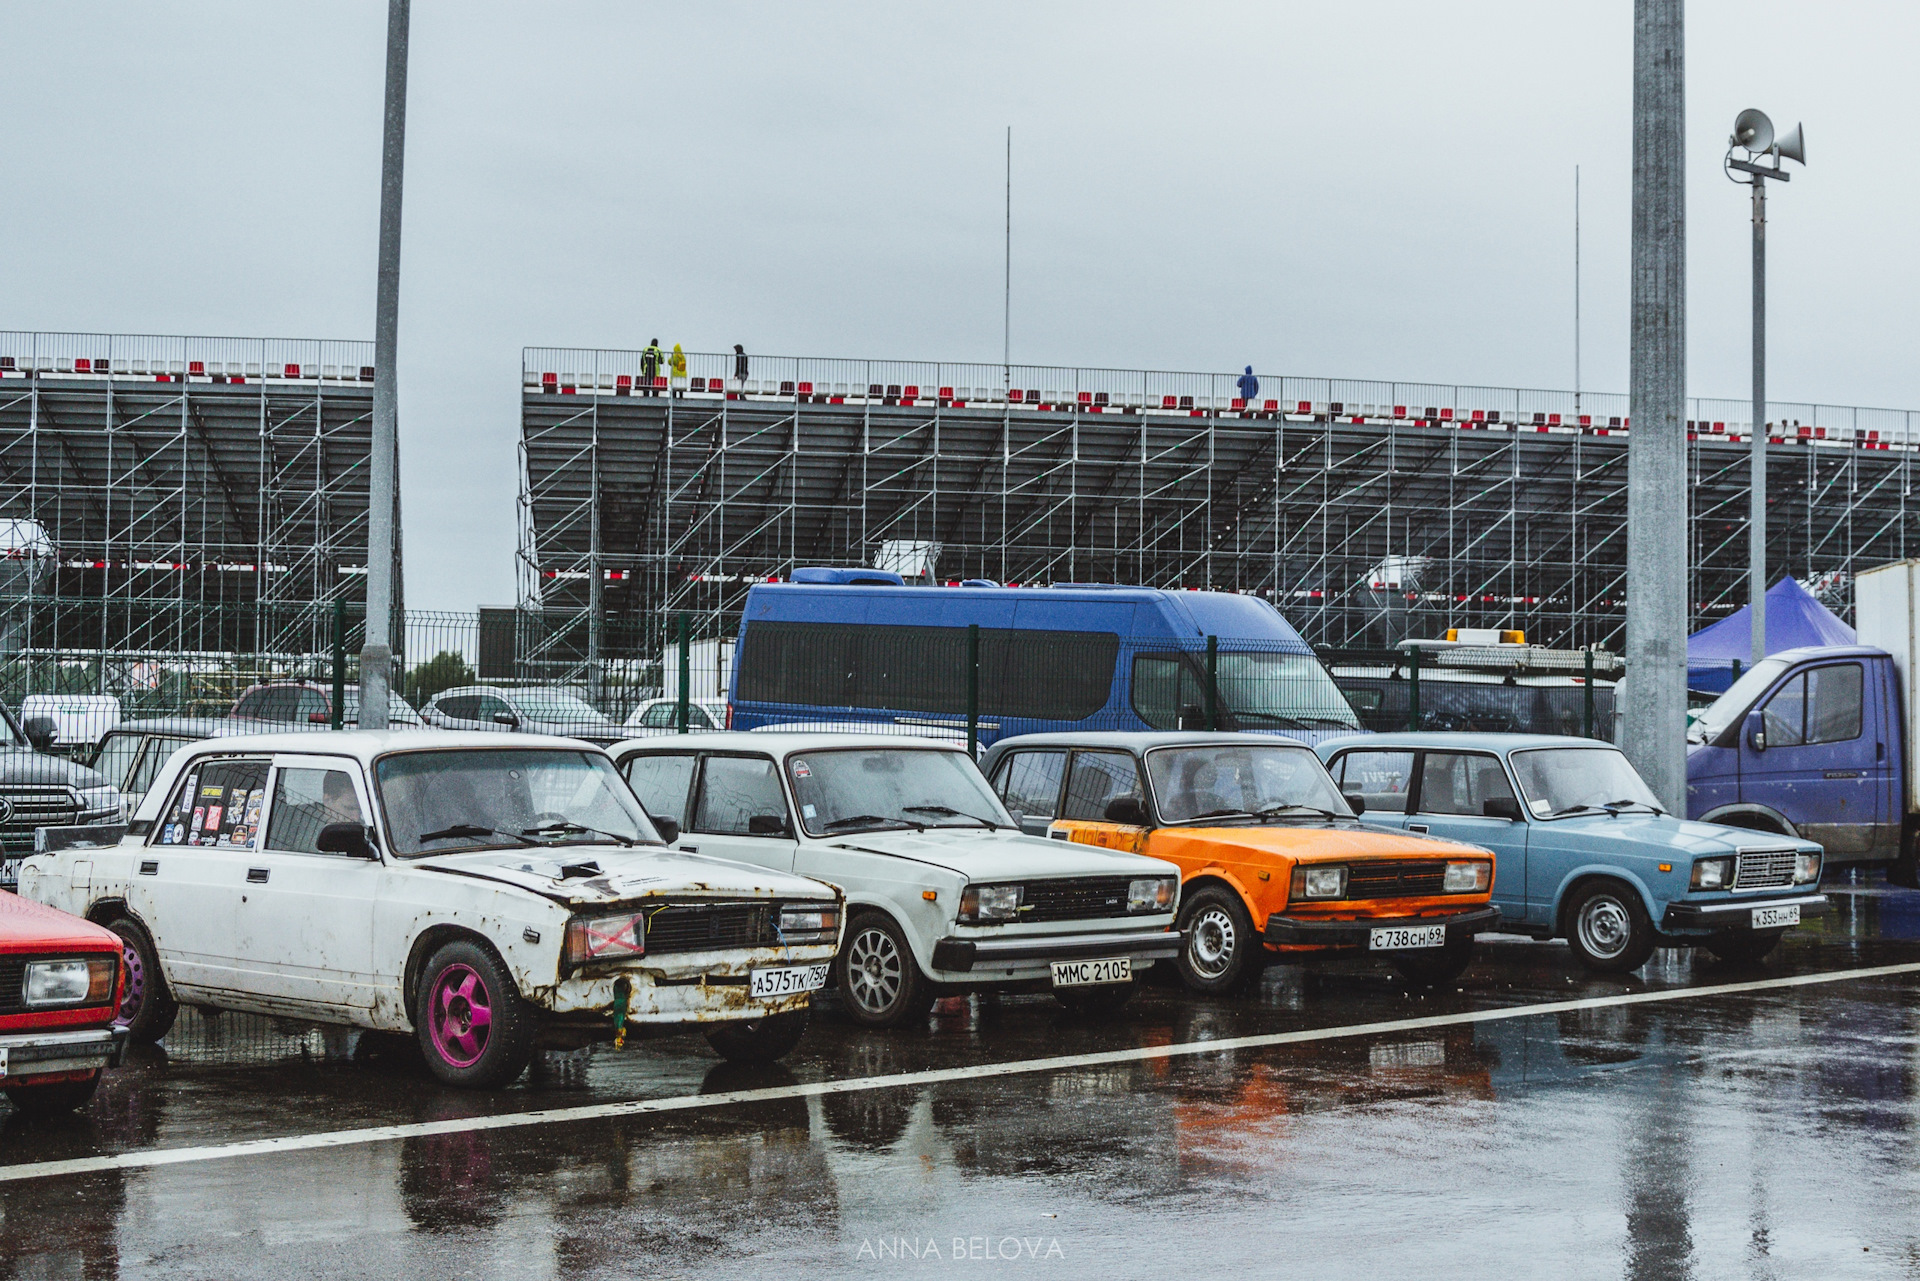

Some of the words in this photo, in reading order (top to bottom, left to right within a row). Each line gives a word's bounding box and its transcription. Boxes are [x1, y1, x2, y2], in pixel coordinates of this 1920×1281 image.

[1789, 907, 1798, 918] 69
[1428, 928, 1441, 940] 69
[808, 966, 827, 982] 750
[1093, 961, 1129, 981] 2105
